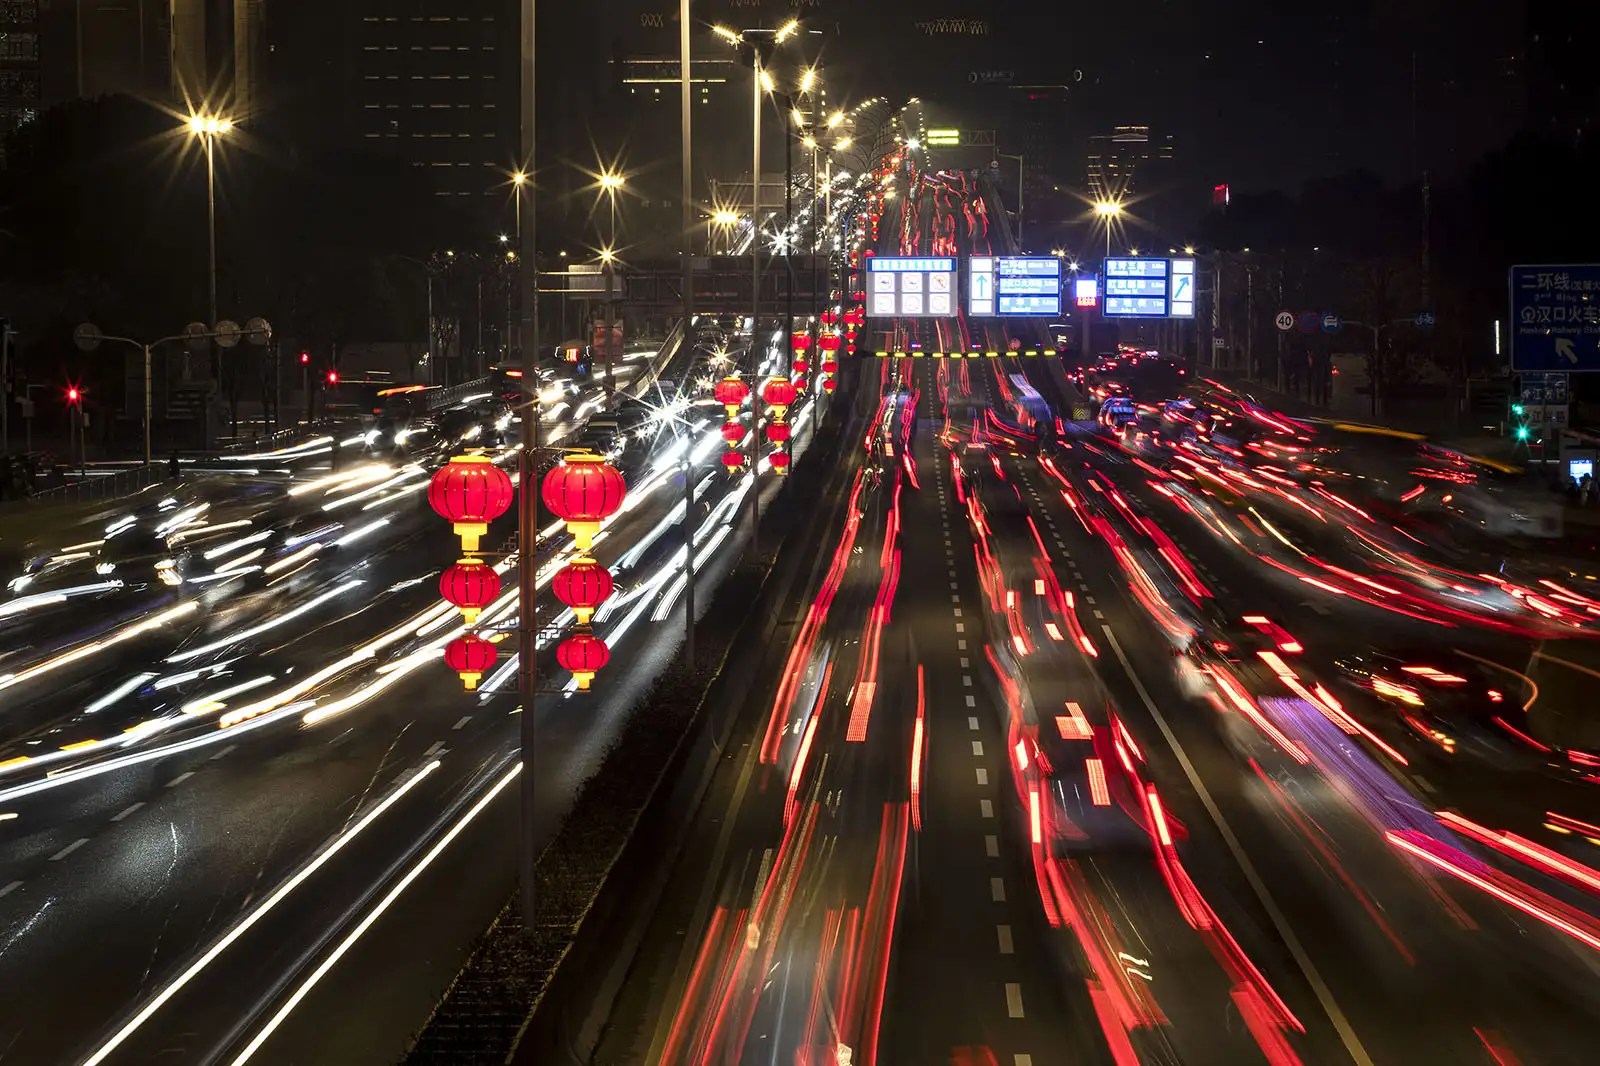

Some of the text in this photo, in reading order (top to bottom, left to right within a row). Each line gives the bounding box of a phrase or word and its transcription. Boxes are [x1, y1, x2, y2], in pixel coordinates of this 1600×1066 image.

[1278, 315, 1291, 326] 40
[1536, 305, 1600, 324] 汉口火车
